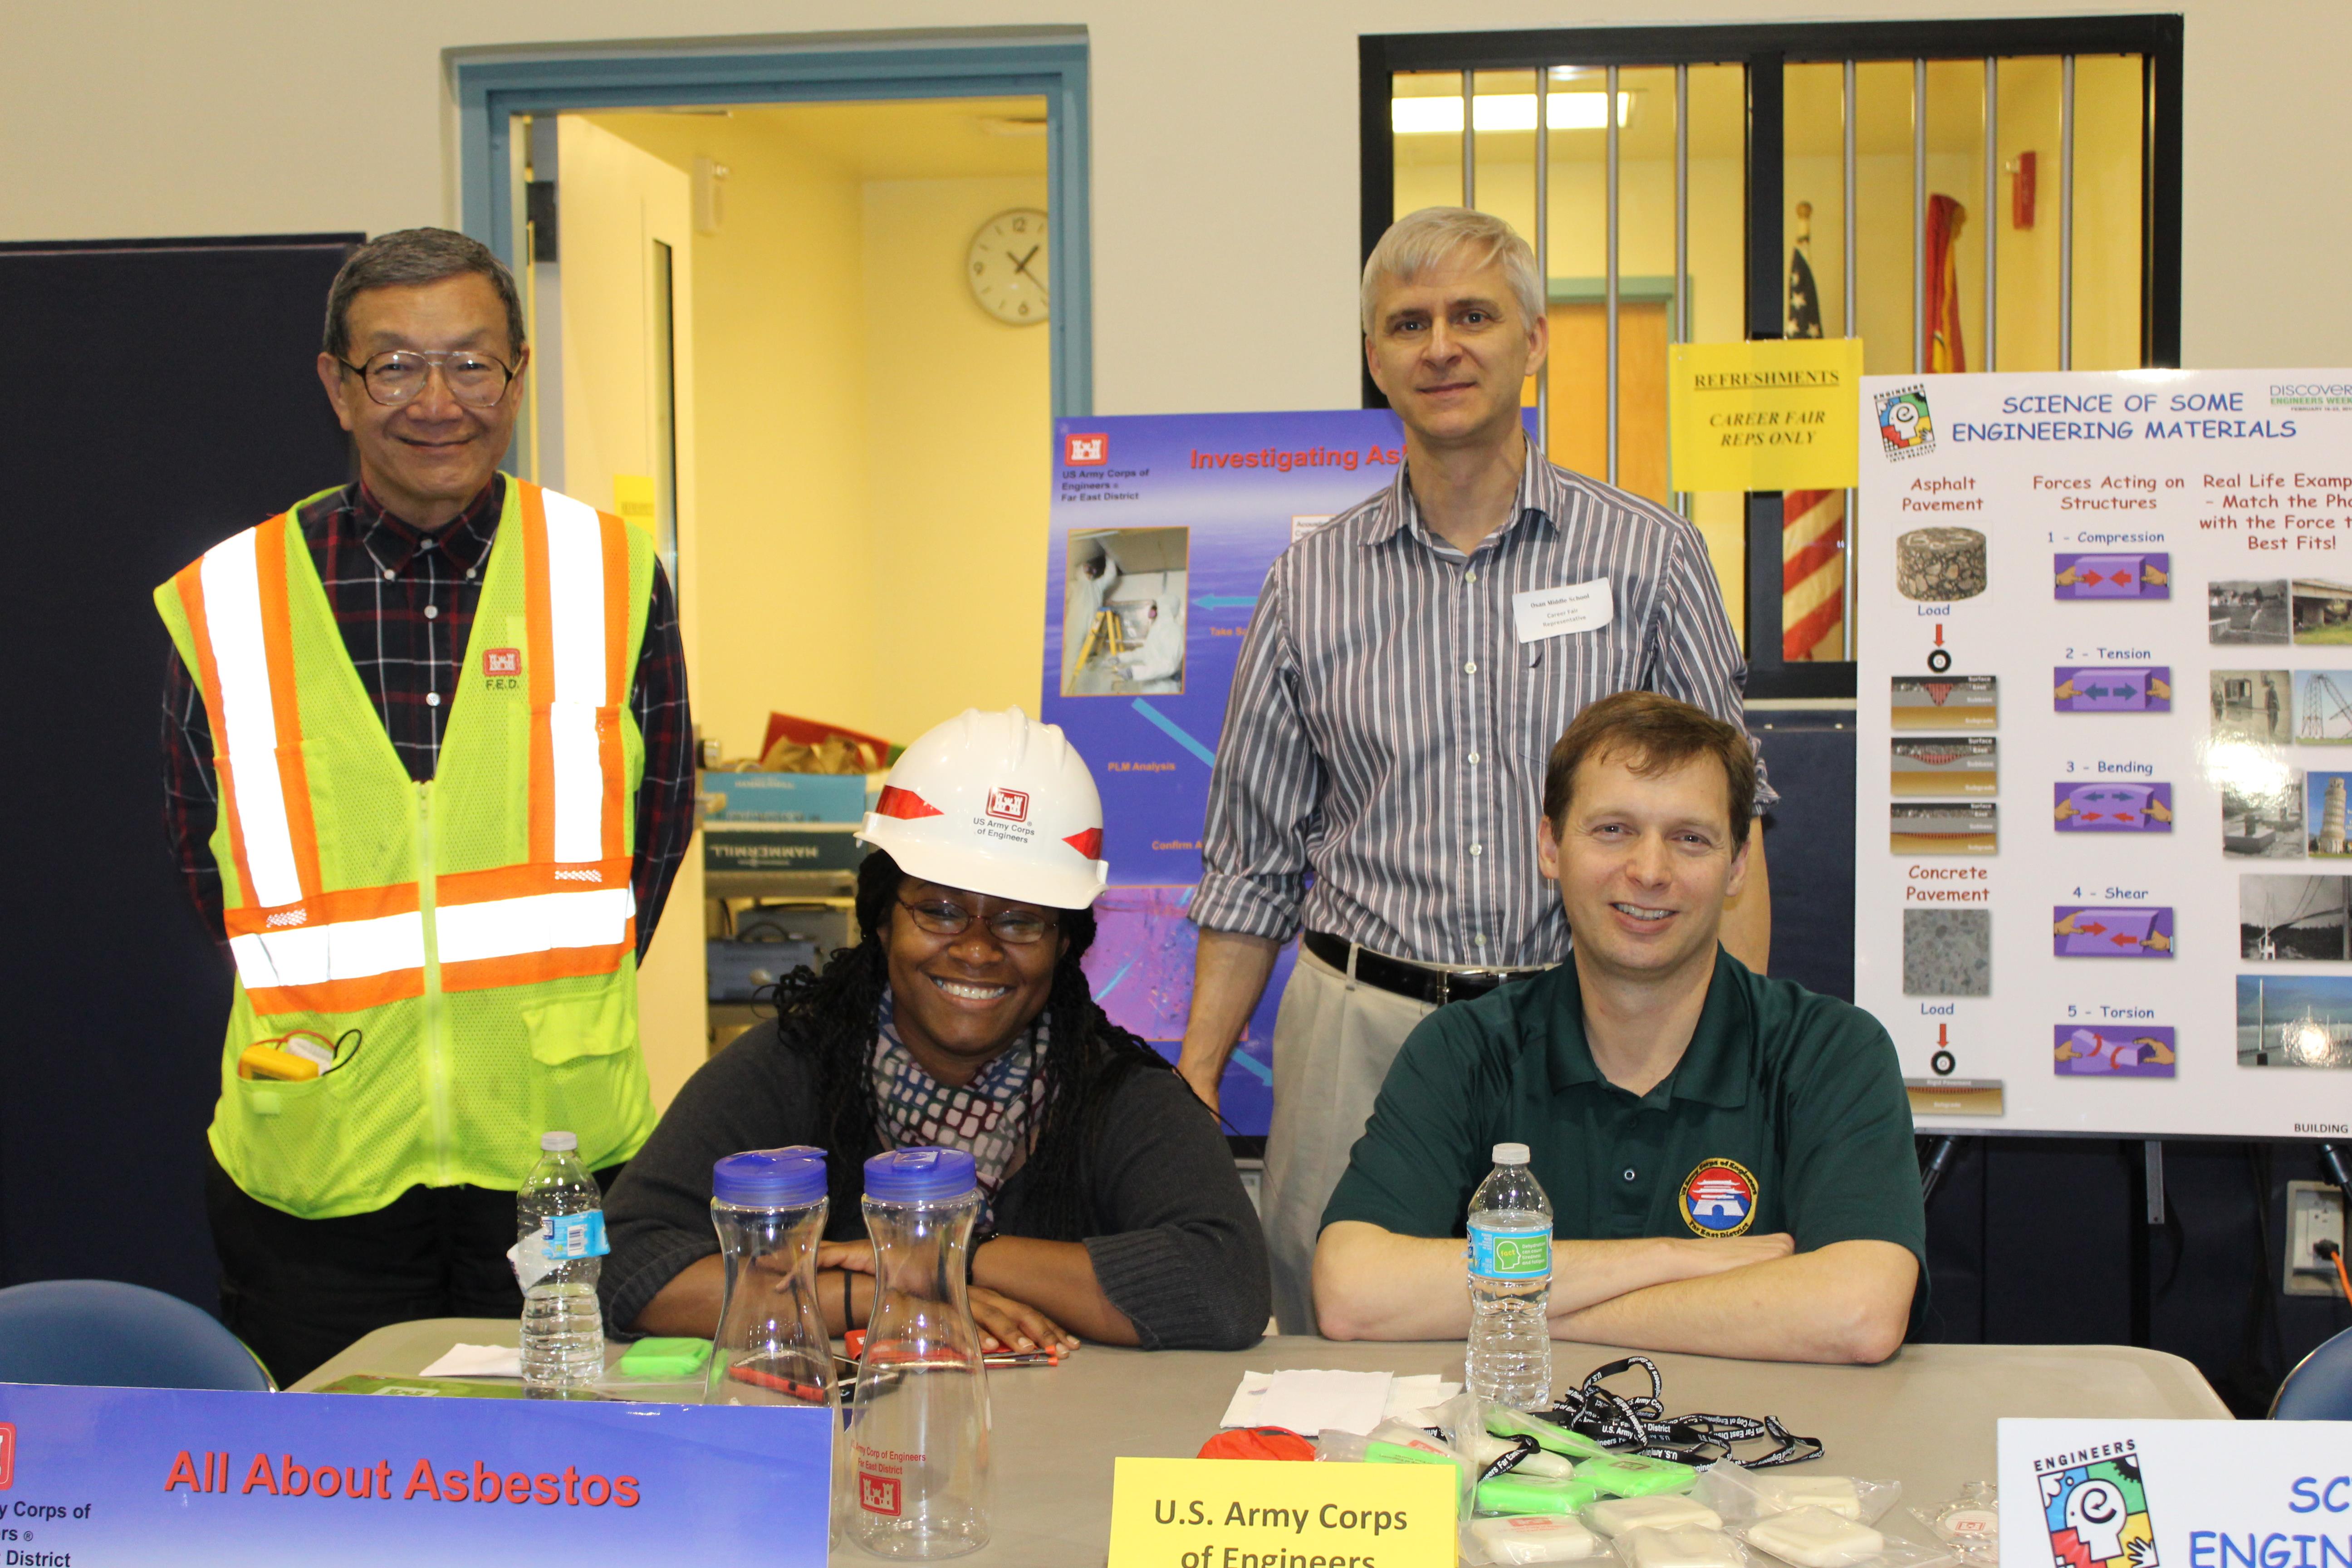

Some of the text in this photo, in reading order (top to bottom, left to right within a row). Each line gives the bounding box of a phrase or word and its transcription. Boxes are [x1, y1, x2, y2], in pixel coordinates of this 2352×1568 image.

[1694, 370, 1839, 387] REFRESHMENTS
[1873, 383, 1924, 400] ENGINEERS
[2002, 392, 2244, 415] SCIENCE OF SOME
[2270, 397, 2323, 405] ENGINEERS
[1710, 410, 1825, 427] CAREER FAIR
[1953, 420, 2297, 442] ENGINEERING MATERIALS
[1721, 431, 1817, 447] REPS ONLY
[1190, 444, 1407, 472] Investigating As
[1062, 470, 1076, 479] US
[1079, 470, 1104, 480] Army
[1107, 469, 1136, 479] Corps
[2204, 474, 2240, 487] Real
[2250, 473, 2285, 487] Life
[1062, 482, 1110, 492] Engineers
[1911, 476, 1976, 495] Asphalt
[2033, 475, 2185, 492] Forces Acting on
[1080, 493, 1101, 501] East
[1104, 492, 1139, 500] District
[2060, 495, 2157, 510] Structures
[2222, 495, 2278, 509] Match
[2288, 494, 2317, 508] the
[1902, 498, 1983, 512] Pavement
[2200, 515, 2237, 529] with
[2246, 514, 2275, 529] the
[2285, 515, 2335, 529] Force
[2048, 531, 2165, 546] 1 Compression
[2249, 535, 2336, 550] Best Fits!
[1547, 598, 1568, 606] Middle
[1569, 593, 1590, 602] School
[1547, 610, 1566, 619] Career
[1918, 604, 1950, 616] Load
[1543, 615, 1587, 628] Representative
[2066, 647, 2151, 660] 2 Tension
[1108, 762, 1176, 773] PLM Analysis
[2067, 761, 2153, 776] 3 Bending
[973, 817, 1035, 836] US Army Corps
[988, 829, 1029, 843] Engineers
[1152, 840, 1193, 850] Confirm
[1909, 864, 1988, 880] Concrete
[1906, 886, 1990, 902] Pavement
[2073, 887, 2149, 900] 4 Shear
[1921, 1003, 1954, 1016] Load
[2068, 1005, 2155, 1019] 5 Torsion
[2294, 1123, 2348, 1133] BUILDING
[1730, 1162, 1757, 1195] Engineers
[1720, 1222, 1749, 1238] District
[1602, 1425, 1633, 1440] U.S. Army
[1647, 1423, 1671, 1433] District
[867, 1447, 880, 1460] Corp
[889, 1451, 926, 1463] Engineers
[1665, 1450, 1678, 1460] U.S.
[2033, 1439, 2136, 1472] ENGINEERS
[865, 1460, 877, 1471] East
[878, 1464, 903, 1475] District
[1497, 1458, 1509, 1470] Far
[164, 1450, 640, 1507] All About Asbestos
[14, 1500, 92, 1521] Corps of
[1154, 1499, 1409, 1536] U.S. Army Corps
[7, 1549, 71, 1568] District
[1181, 1545, 1376, 1568] of Engineers
